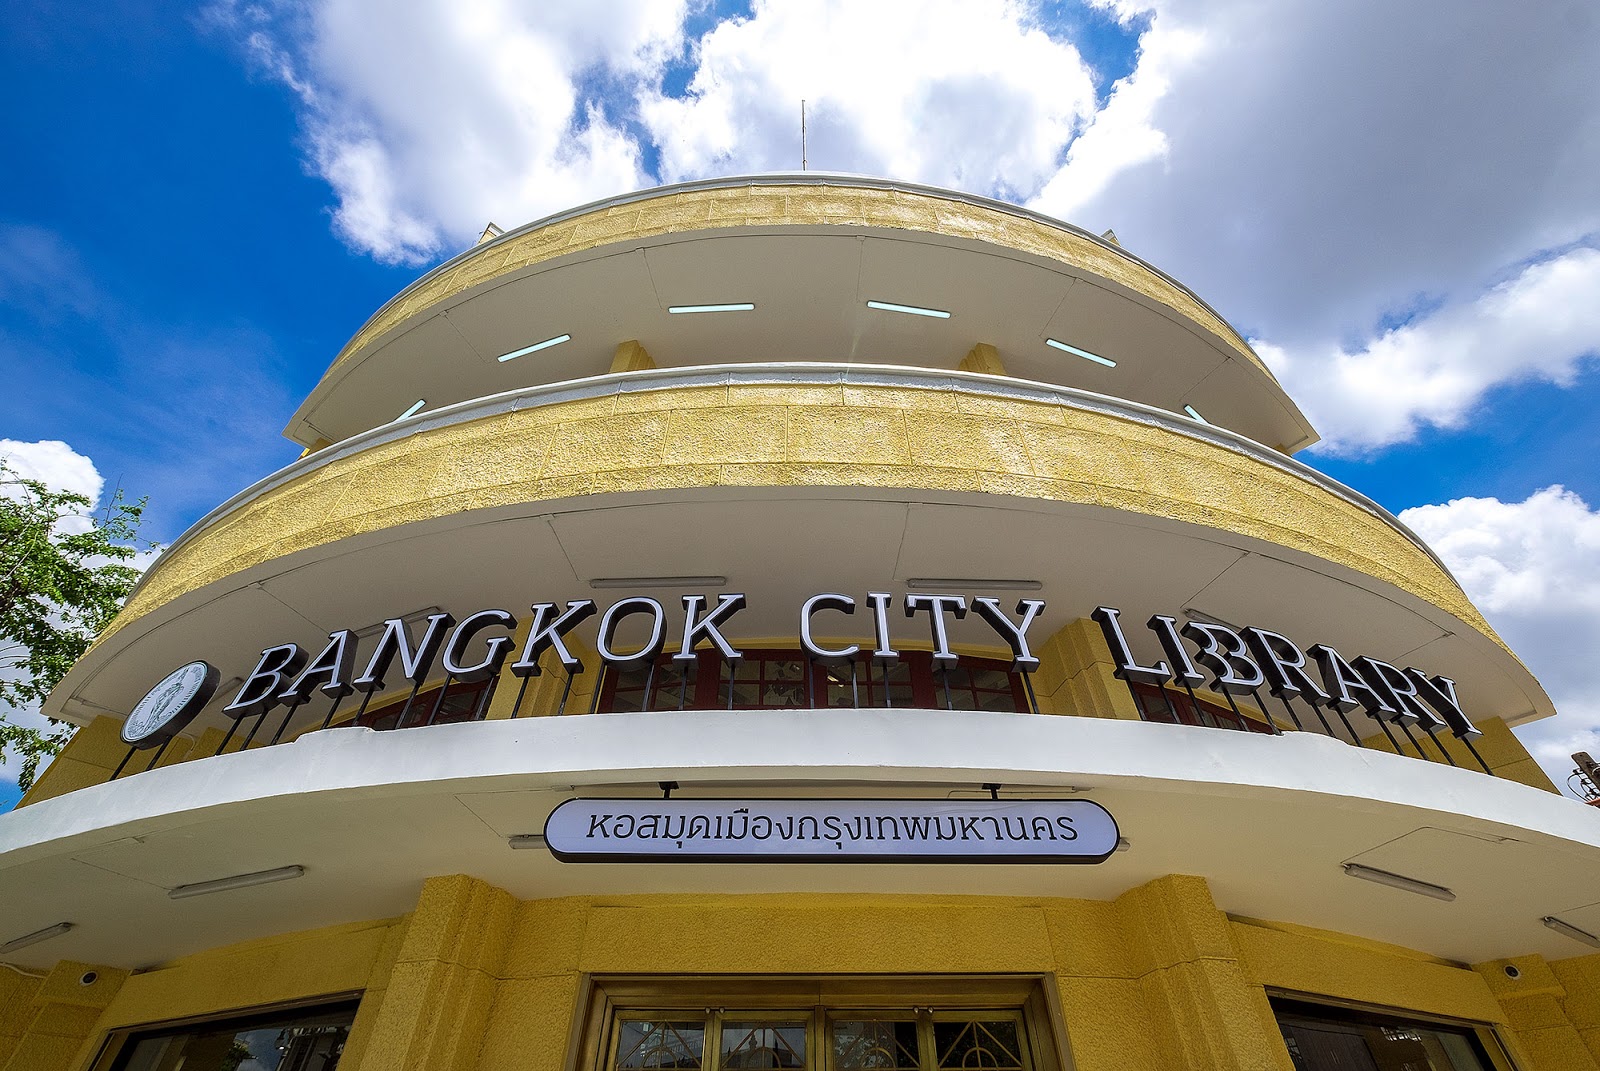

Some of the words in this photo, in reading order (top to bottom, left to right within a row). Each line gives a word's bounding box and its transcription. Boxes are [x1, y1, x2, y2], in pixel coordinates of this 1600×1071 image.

[223, 593, 746, 714] BANGKOK
[800, 592, 1046, 669] CITY
[1093, 606, 1483, 738] LIBRARY
[585, 808, 1078, 849] หอสมุดเมืองกรุงเทพมหานคร
